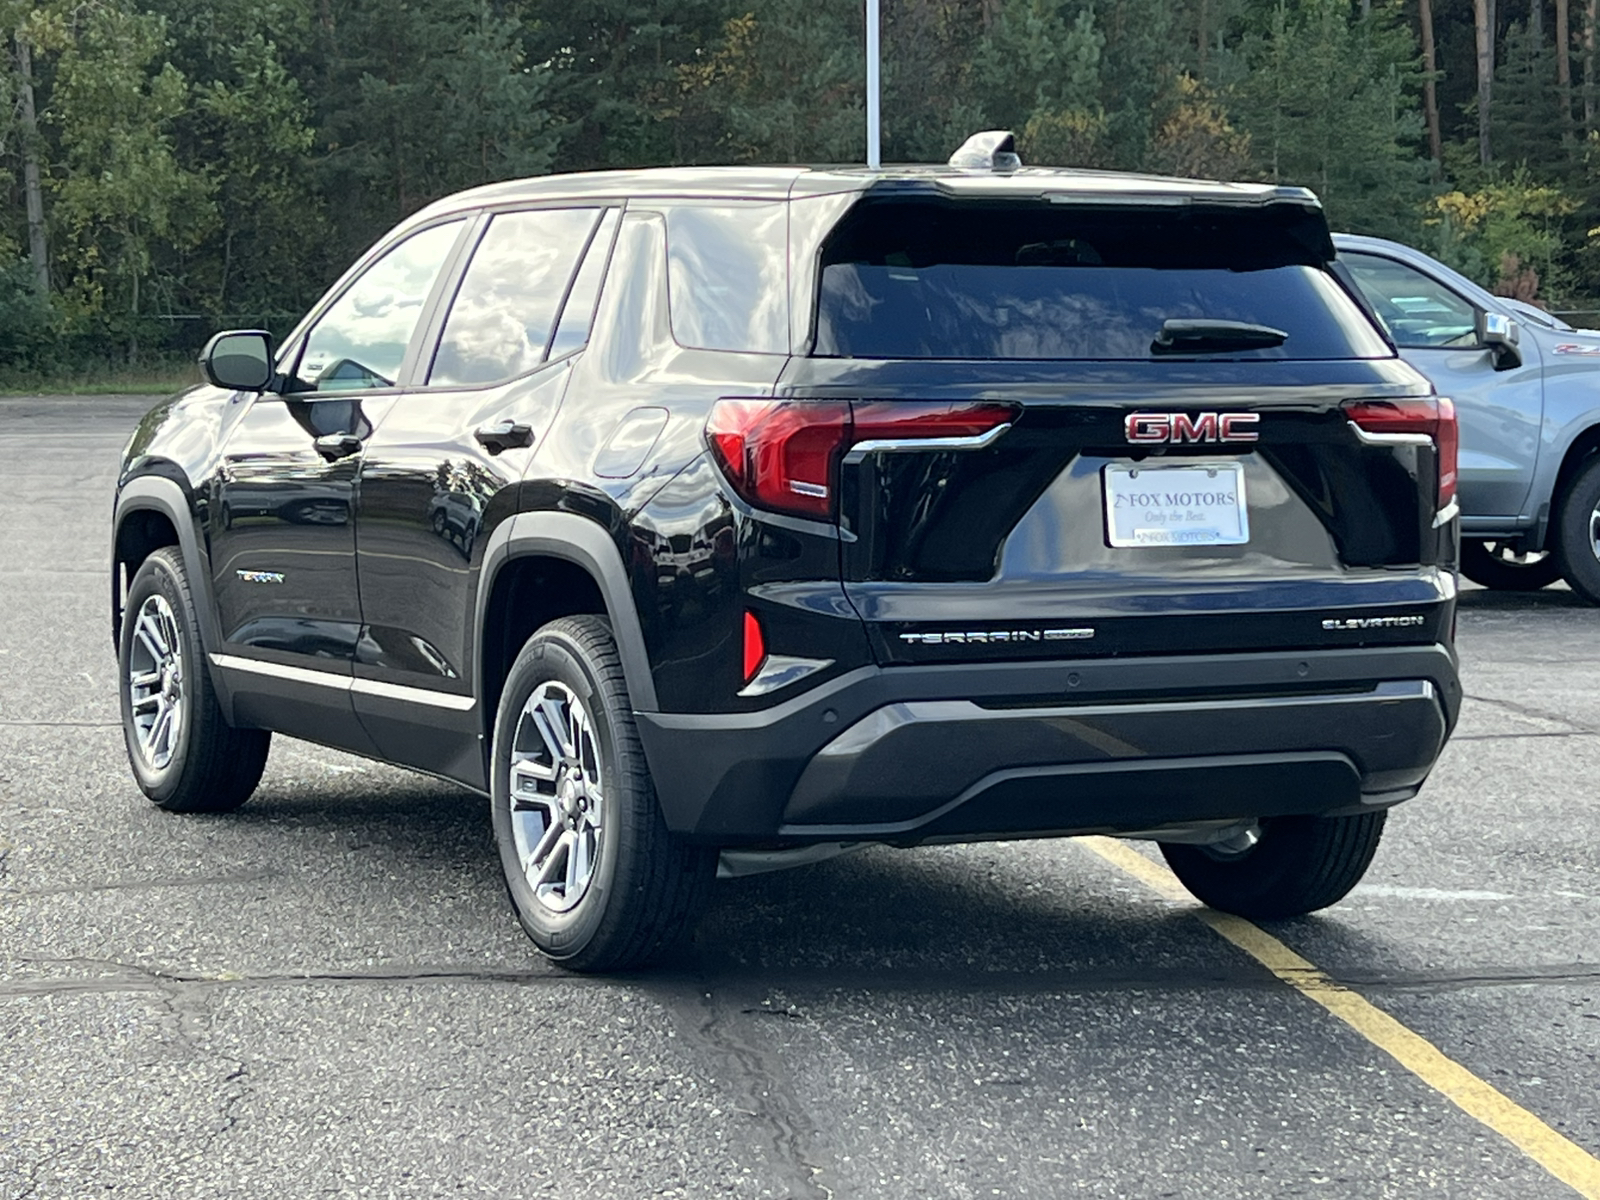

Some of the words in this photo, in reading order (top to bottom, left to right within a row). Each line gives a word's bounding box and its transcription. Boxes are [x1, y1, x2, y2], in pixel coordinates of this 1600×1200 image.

[1124, 413, 1260, 443] GMC
[1129, 493, 1161, 507] FOX
[1165, 491, 1235, 506] MOTORS
[1322, 615, 1424, 629] ELEVATION
[900, 630, 1041, 644] TERRAIN
